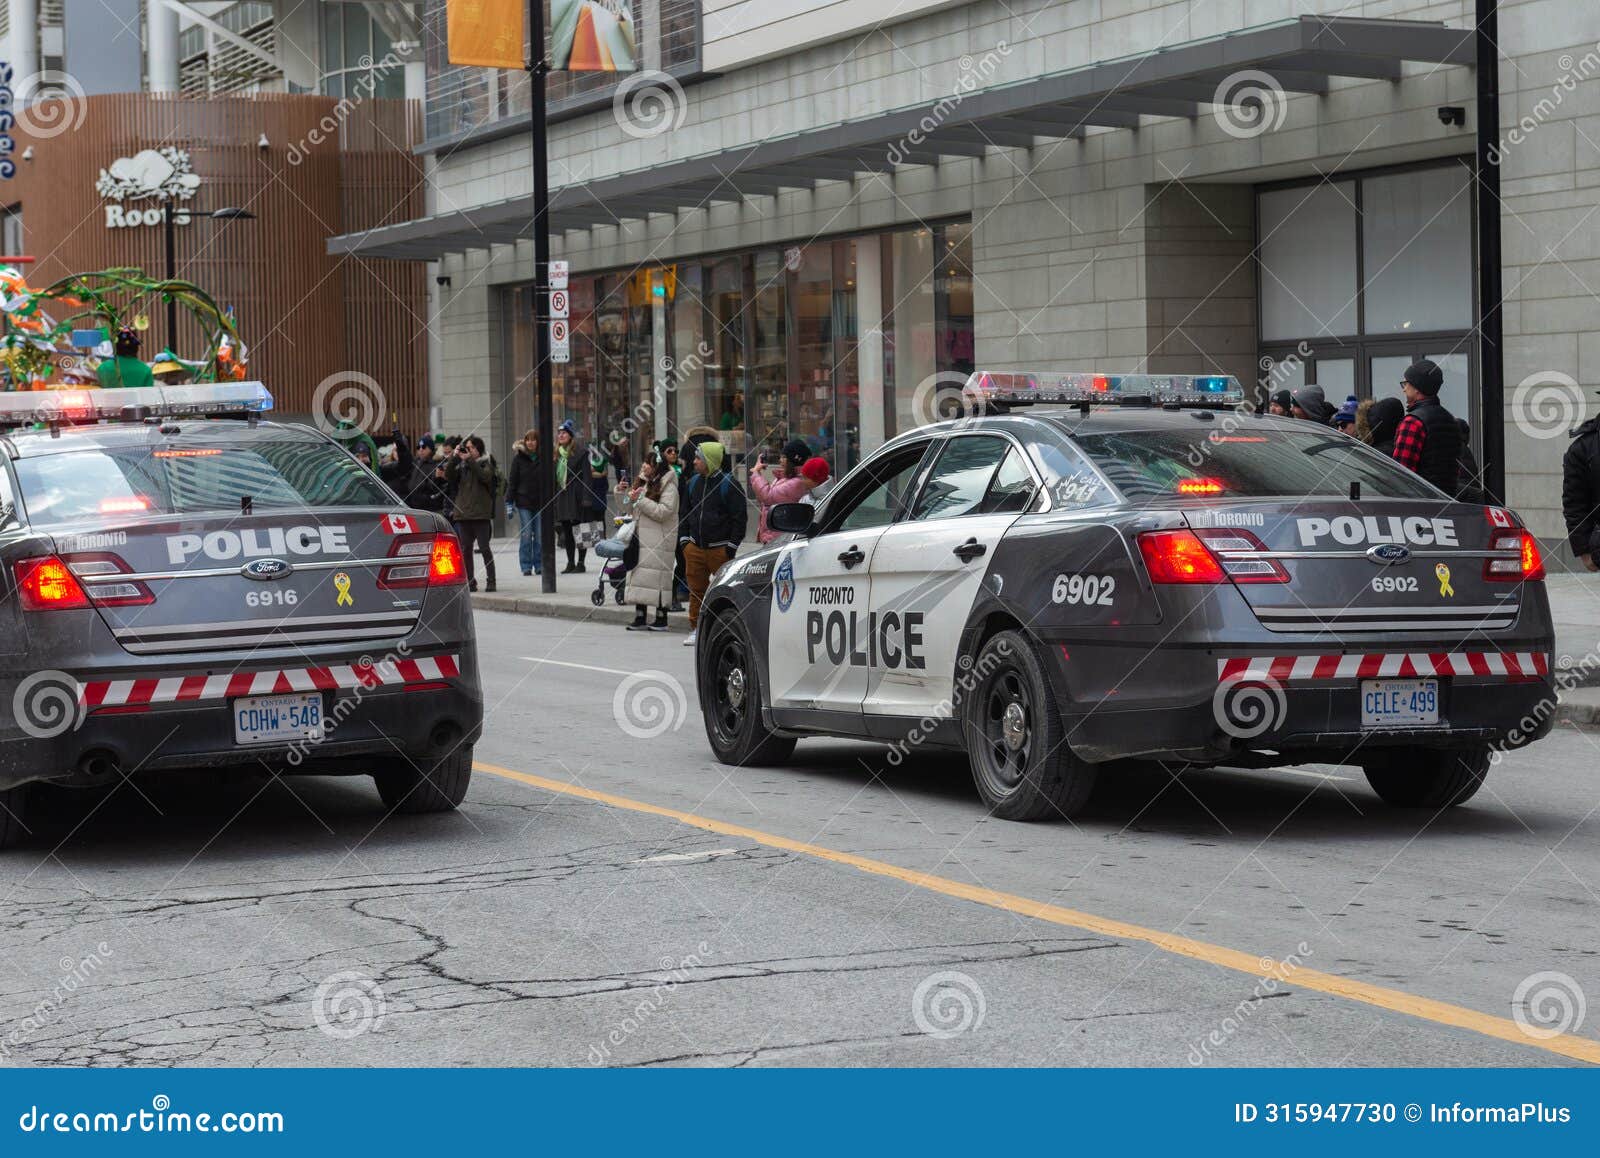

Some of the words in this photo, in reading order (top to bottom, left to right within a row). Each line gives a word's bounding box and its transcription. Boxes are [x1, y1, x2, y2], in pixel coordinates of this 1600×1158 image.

[1212, 510, 1264, 527] TORONTO
[77, 531, 127, 550] TORONTO
[1296, 516, 1460, 547] POLICE
[166, 525, 351, 565] POLICE
[256, 561, 280, 573] Ford
[809, 586, 855, 605] TORONTO
[1051, 574, 1116, 606] 6902
[1372, 577, 1419, 593] 6902
[246, 589, 298, 607] 6916
[806, 610, 926, 670] POLICE
[1365, 692, 1400, 714] CELE
[1409, 691, 1436, 713] 499
[239, 708, 279, 732] CDHW
[289, 705, 320, 728] 548
